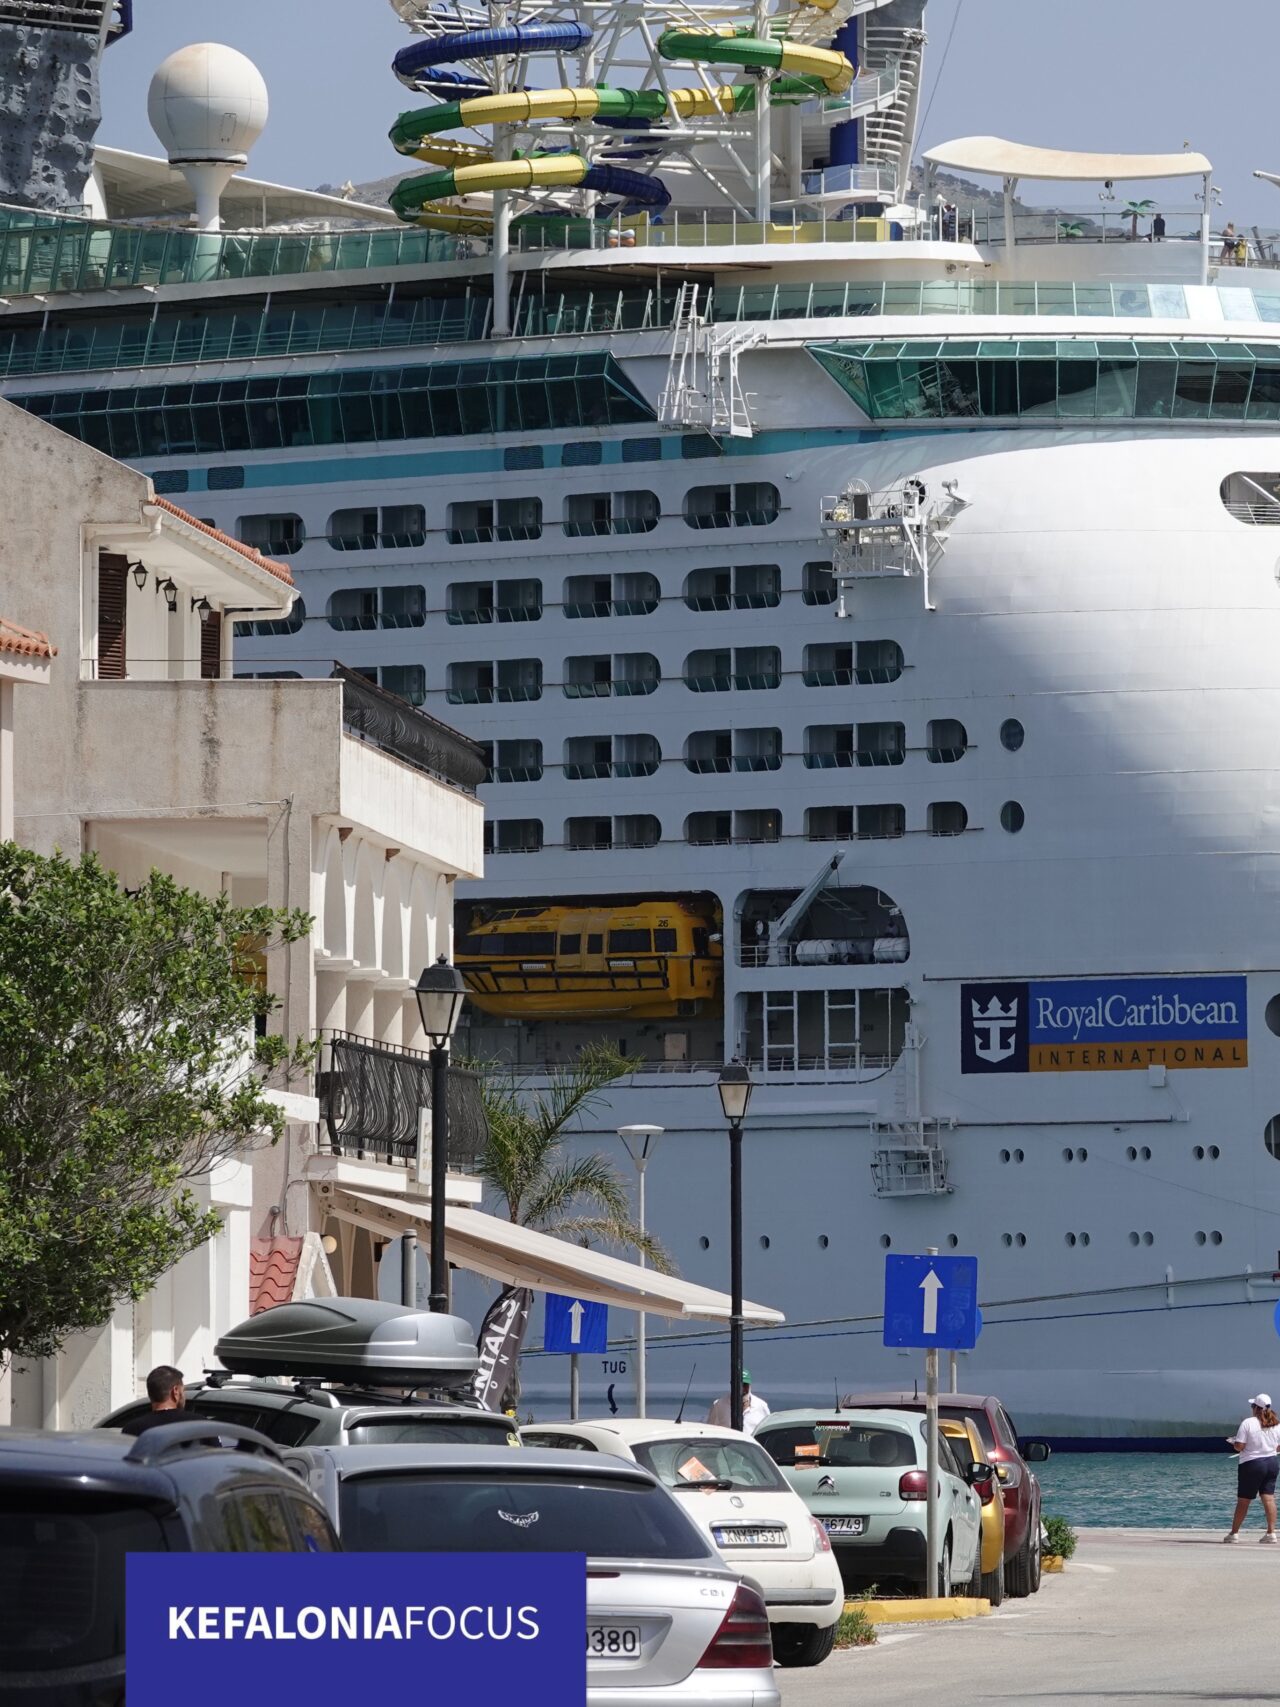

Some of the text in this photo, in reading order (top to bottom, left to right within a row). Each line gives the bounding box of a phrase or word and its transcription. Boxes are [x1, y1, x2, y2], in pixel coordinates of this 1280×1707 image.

[1038, 1046, 1241, 1064] INTERNATIONAL
[602, 1361, 626, 1373] TUG
[831, 1519, 861, 1529] 6749
[587, 1630, 636, 1652] 380
